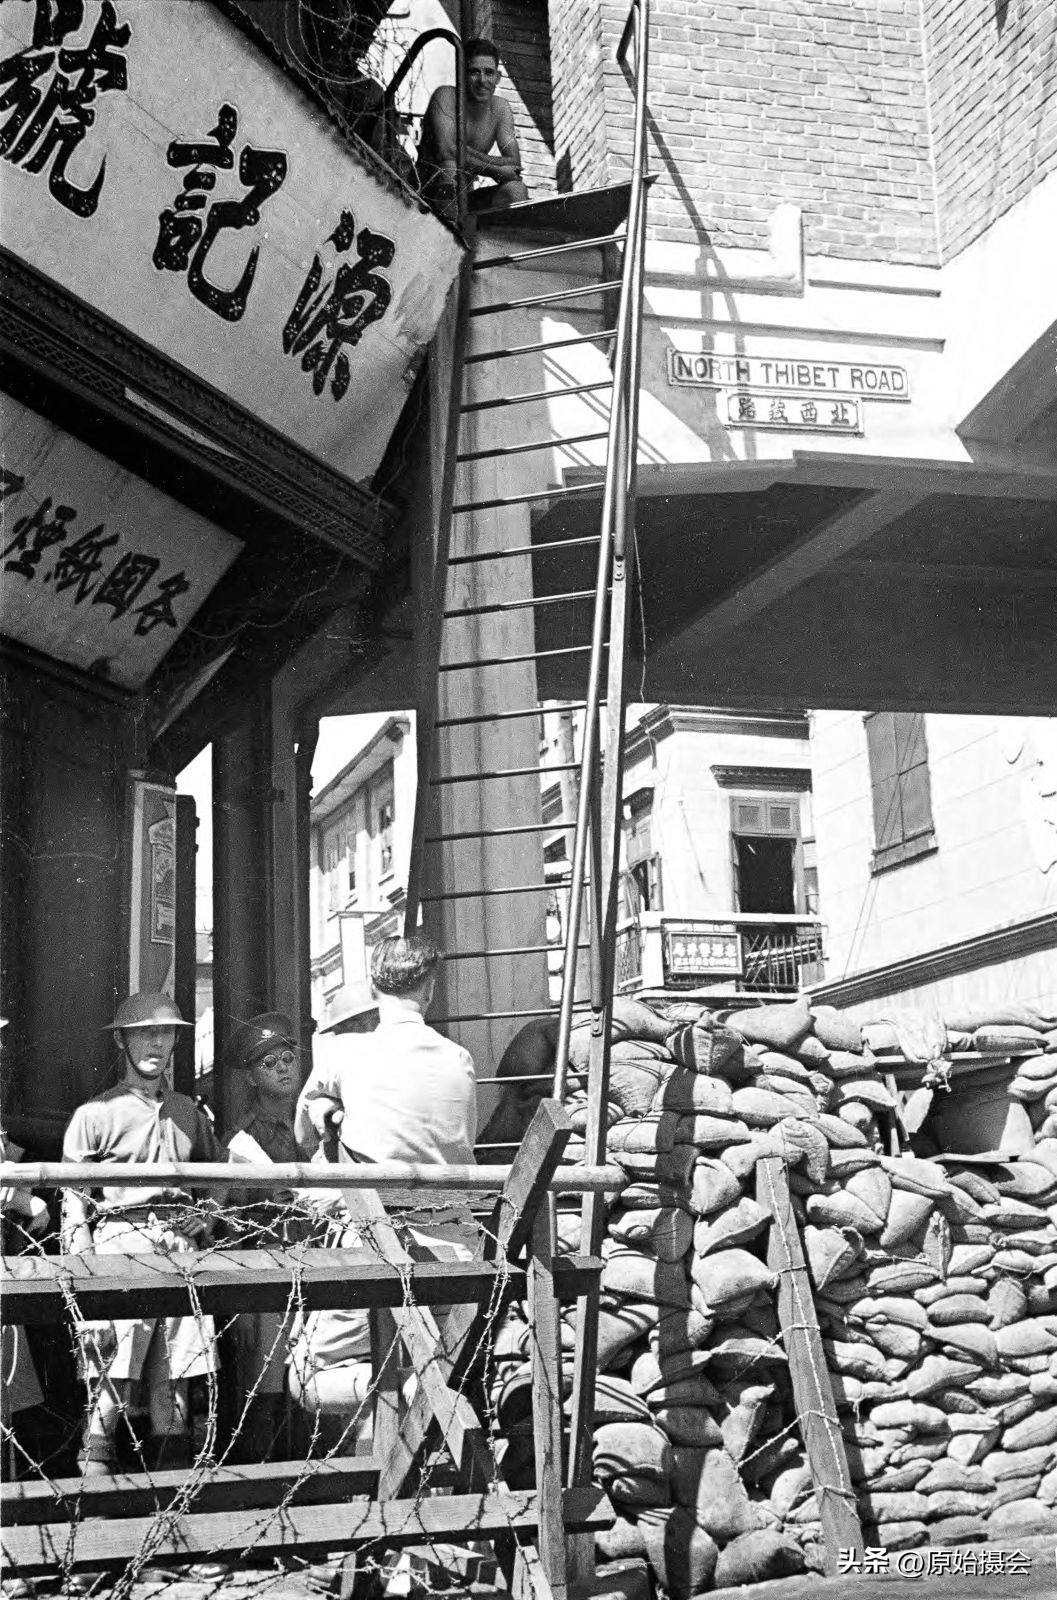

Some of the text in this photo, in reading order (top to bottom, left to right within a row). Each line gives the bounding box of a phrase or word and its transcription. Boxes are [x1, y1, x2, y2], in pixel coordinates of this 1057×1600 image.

[677, 355, 905, 391] NORTH THIBET ROAD
[0, 466, 190, 636] 各國紙煙
